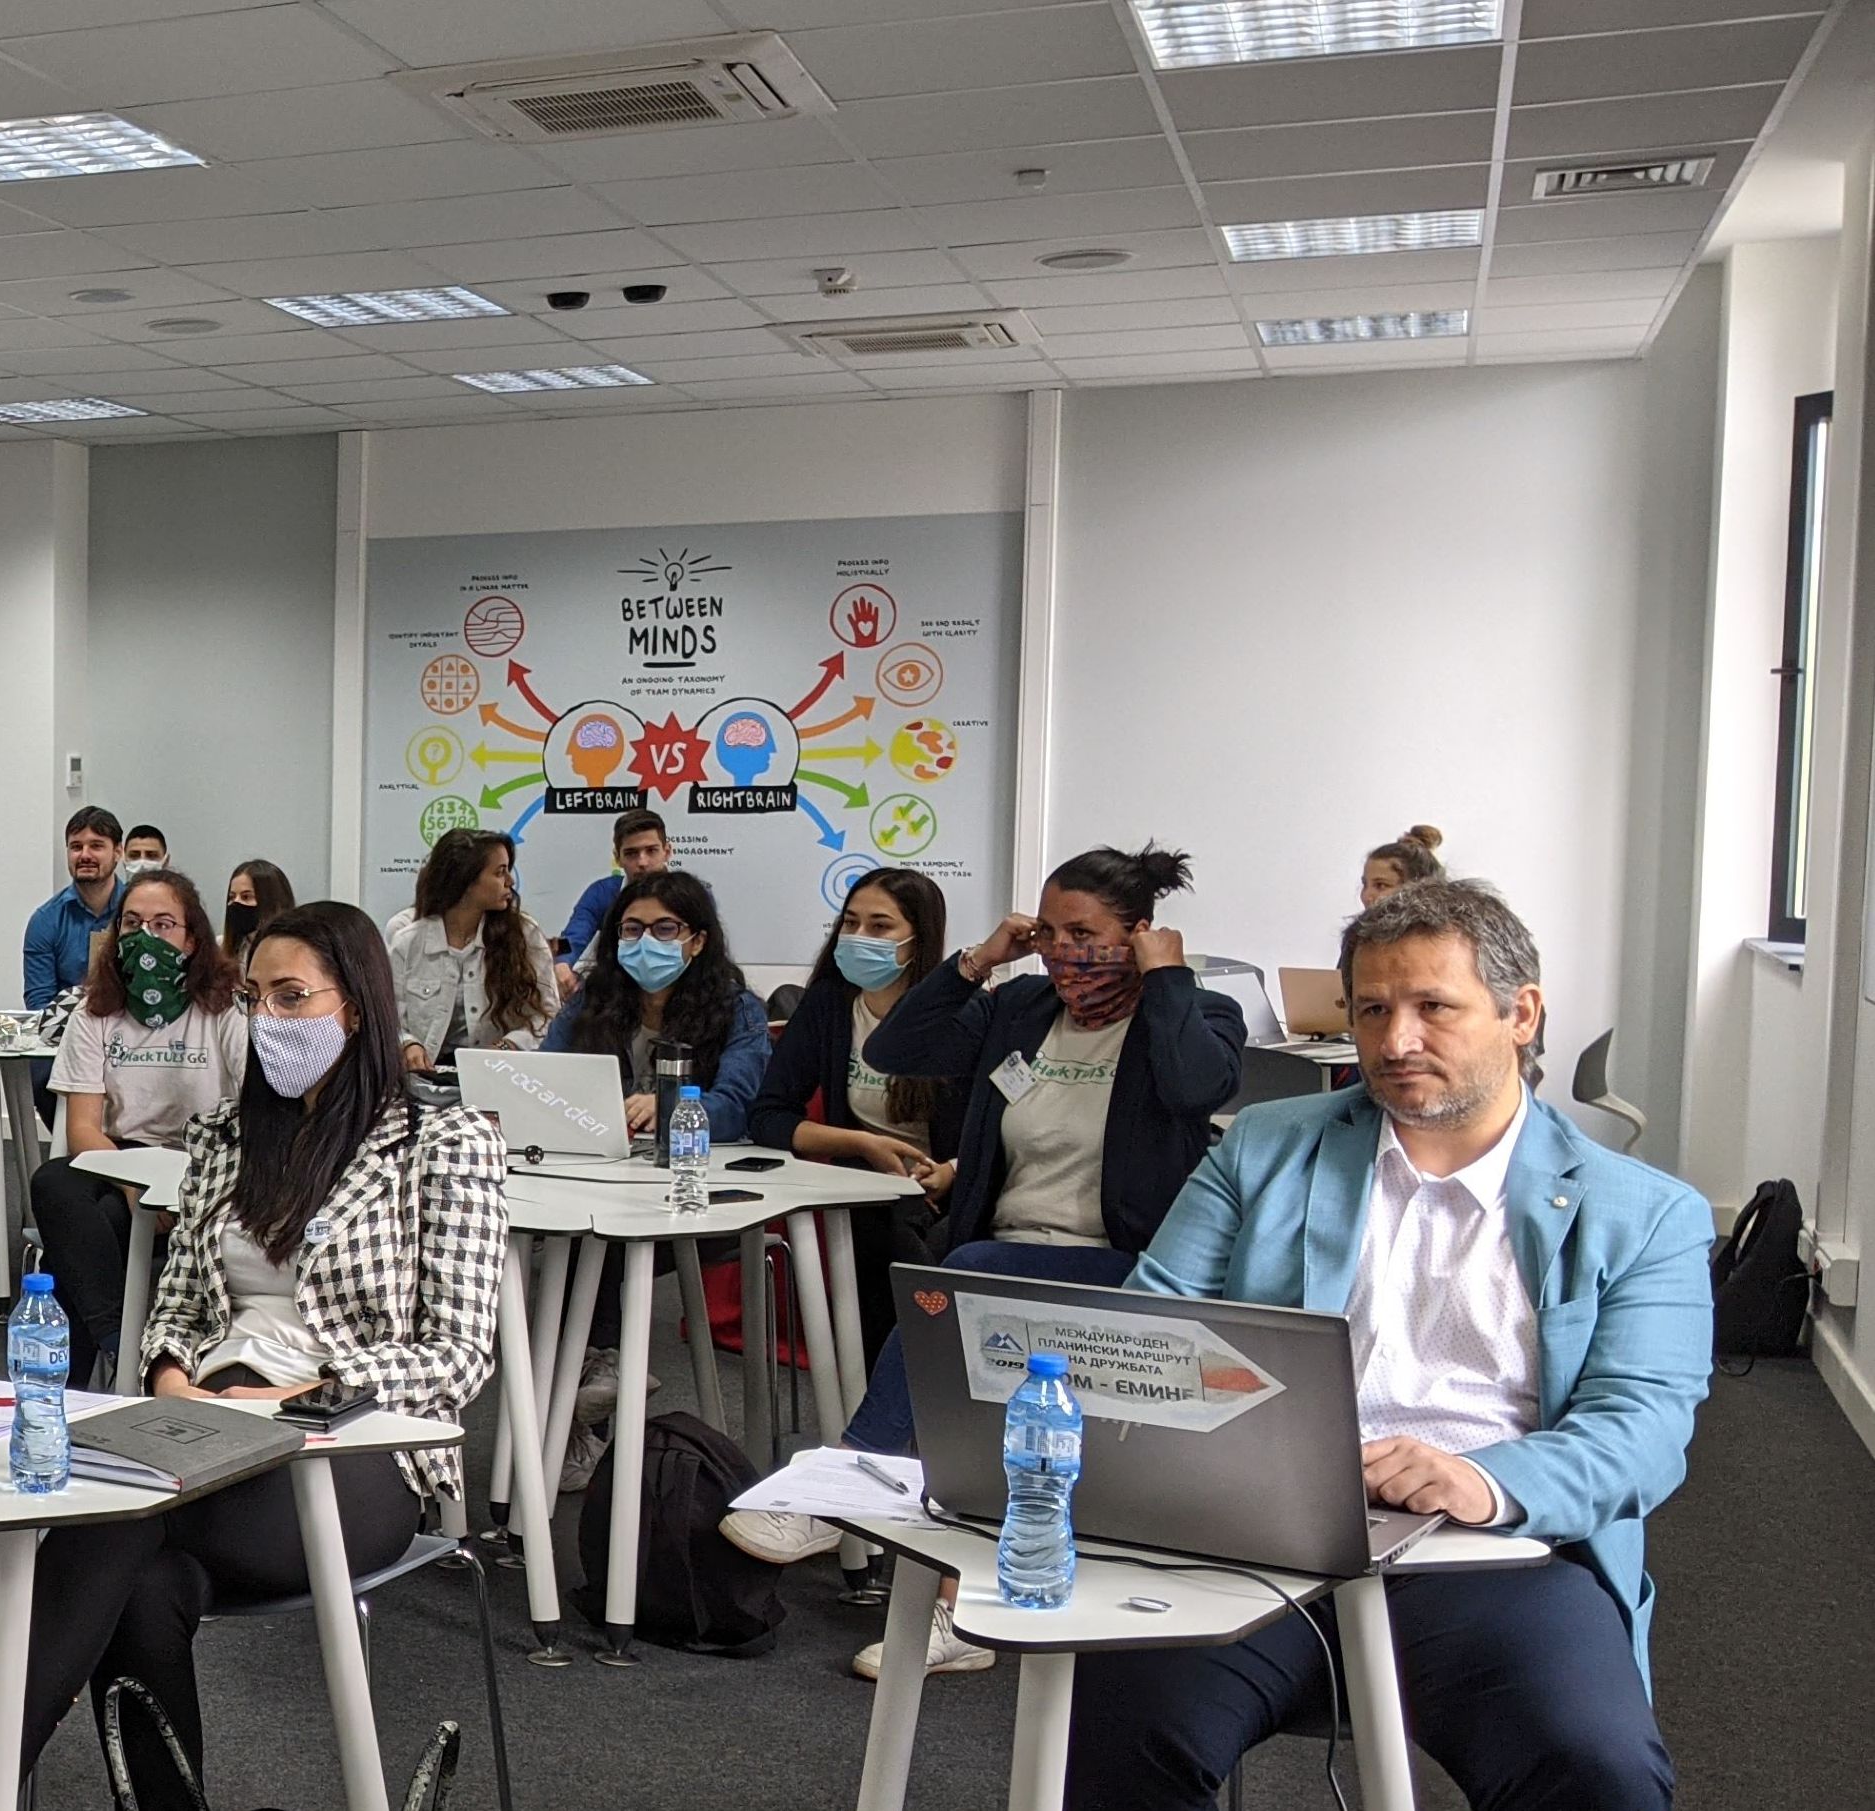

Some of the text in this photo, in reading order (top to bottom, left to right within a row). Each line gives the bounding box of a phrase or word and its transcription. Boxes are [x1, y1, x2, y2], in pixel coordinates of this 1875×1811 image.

[621, 595, 724, 621] BETWEEN
[629, 624, 717, 659] MINDS
[622, 674, 726, 685] AN ONGOING TAXONOMY
[630, 687, 716, 697] OF TEAM DYNAMICS
[649, 742, 687, 775] VS
[672, 847, 734, 856] ENGAGEMENT
[187, 1053, 207, 1064] GG
[1055, 1327, 1169, 1350] МЕЖДУНАРОДЕН
[1038, 1337, 1119, 1357] ПЛАНИНСКИ
[1123, 1350, 1191, 1366] МАРШРУТ
[1068, 1355, 1163, 1375] НА ДРУЖБАТА
[1062, 1372, 1093, 1390] ОМ
[1115, 1379, 1195, 1402] ЕМИНЕ
